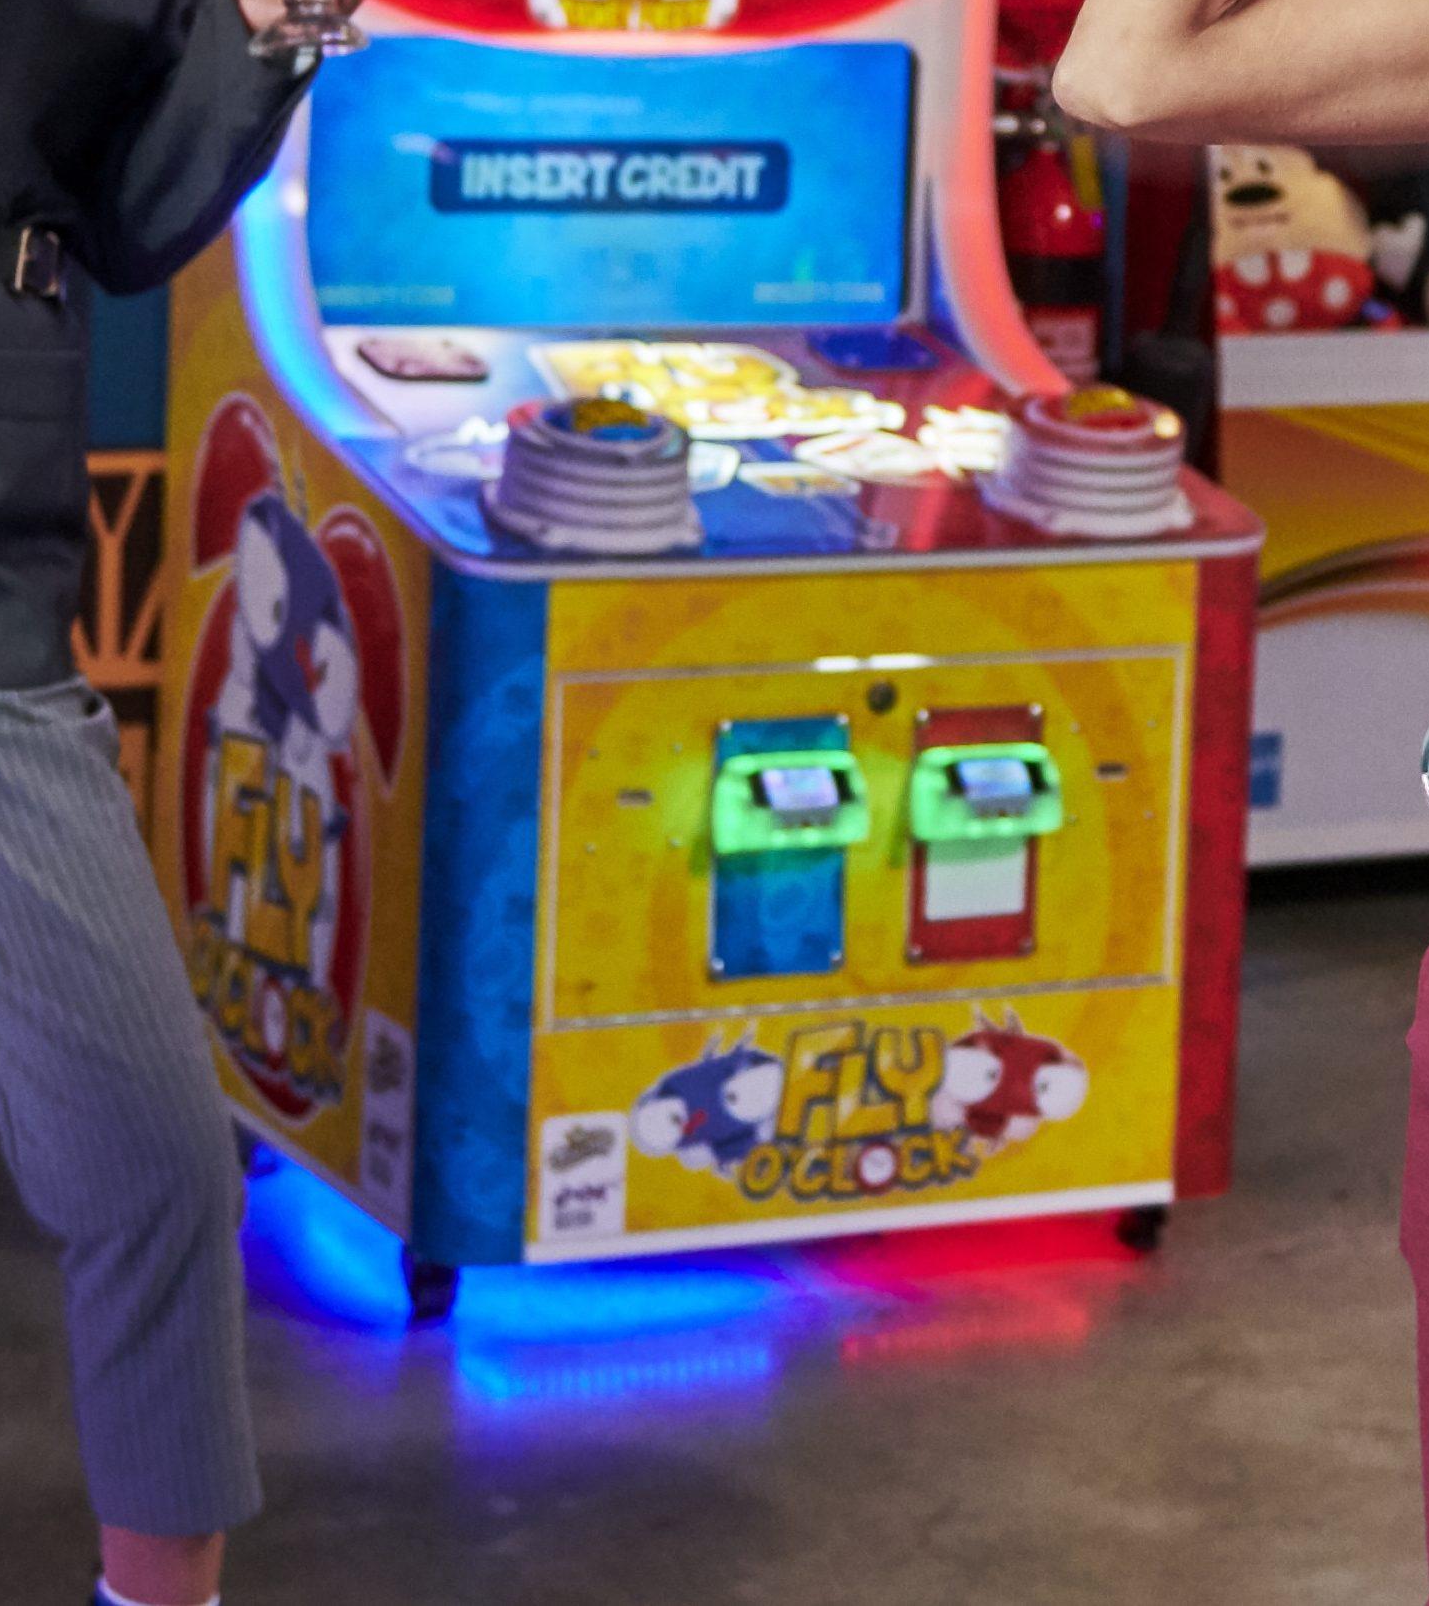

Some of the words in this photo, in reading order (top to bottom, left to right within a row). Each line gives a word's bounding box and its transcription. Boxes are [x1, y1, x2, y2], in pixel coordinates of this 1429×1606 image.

[461, 151, 616, 201] INSERT
[617, 151, 768, 200] CREDIT
[774, 1020, 947, 1142] FLY
